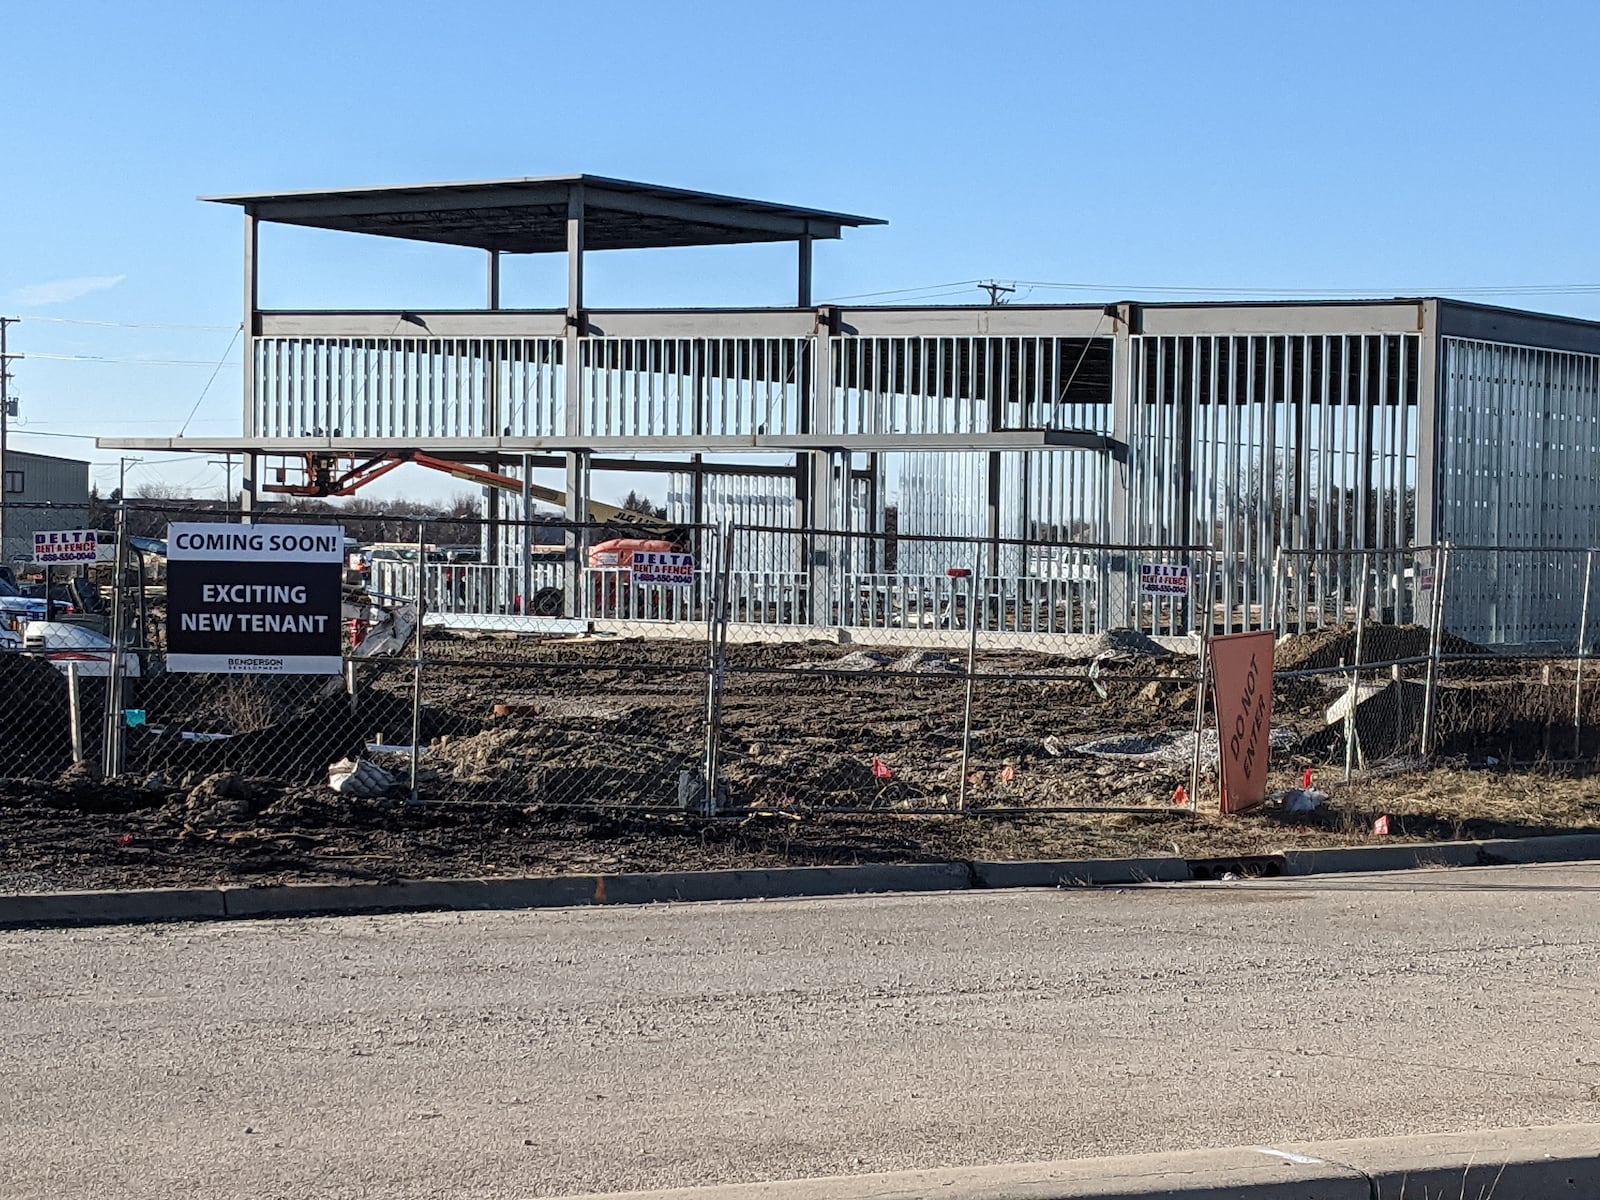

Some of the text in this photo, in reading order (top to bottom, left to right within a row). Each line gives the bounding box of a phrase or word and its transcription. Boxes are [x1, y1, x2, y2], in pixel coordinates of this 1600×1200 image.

[35, 532, 96, 544] DELTA
[176, 533, 337, 552] COMING SOON!
[634, 553, 693, 566] DELTA
[1142, 565, 1188, 576] DELTA
[202, 584, 307, 604] EXCITING
[181, 613, 328, 633] NEW TENANT
[1230, 652, 1259, 762] DO NOT
[1243, 693, 1266, 779] ENTER
